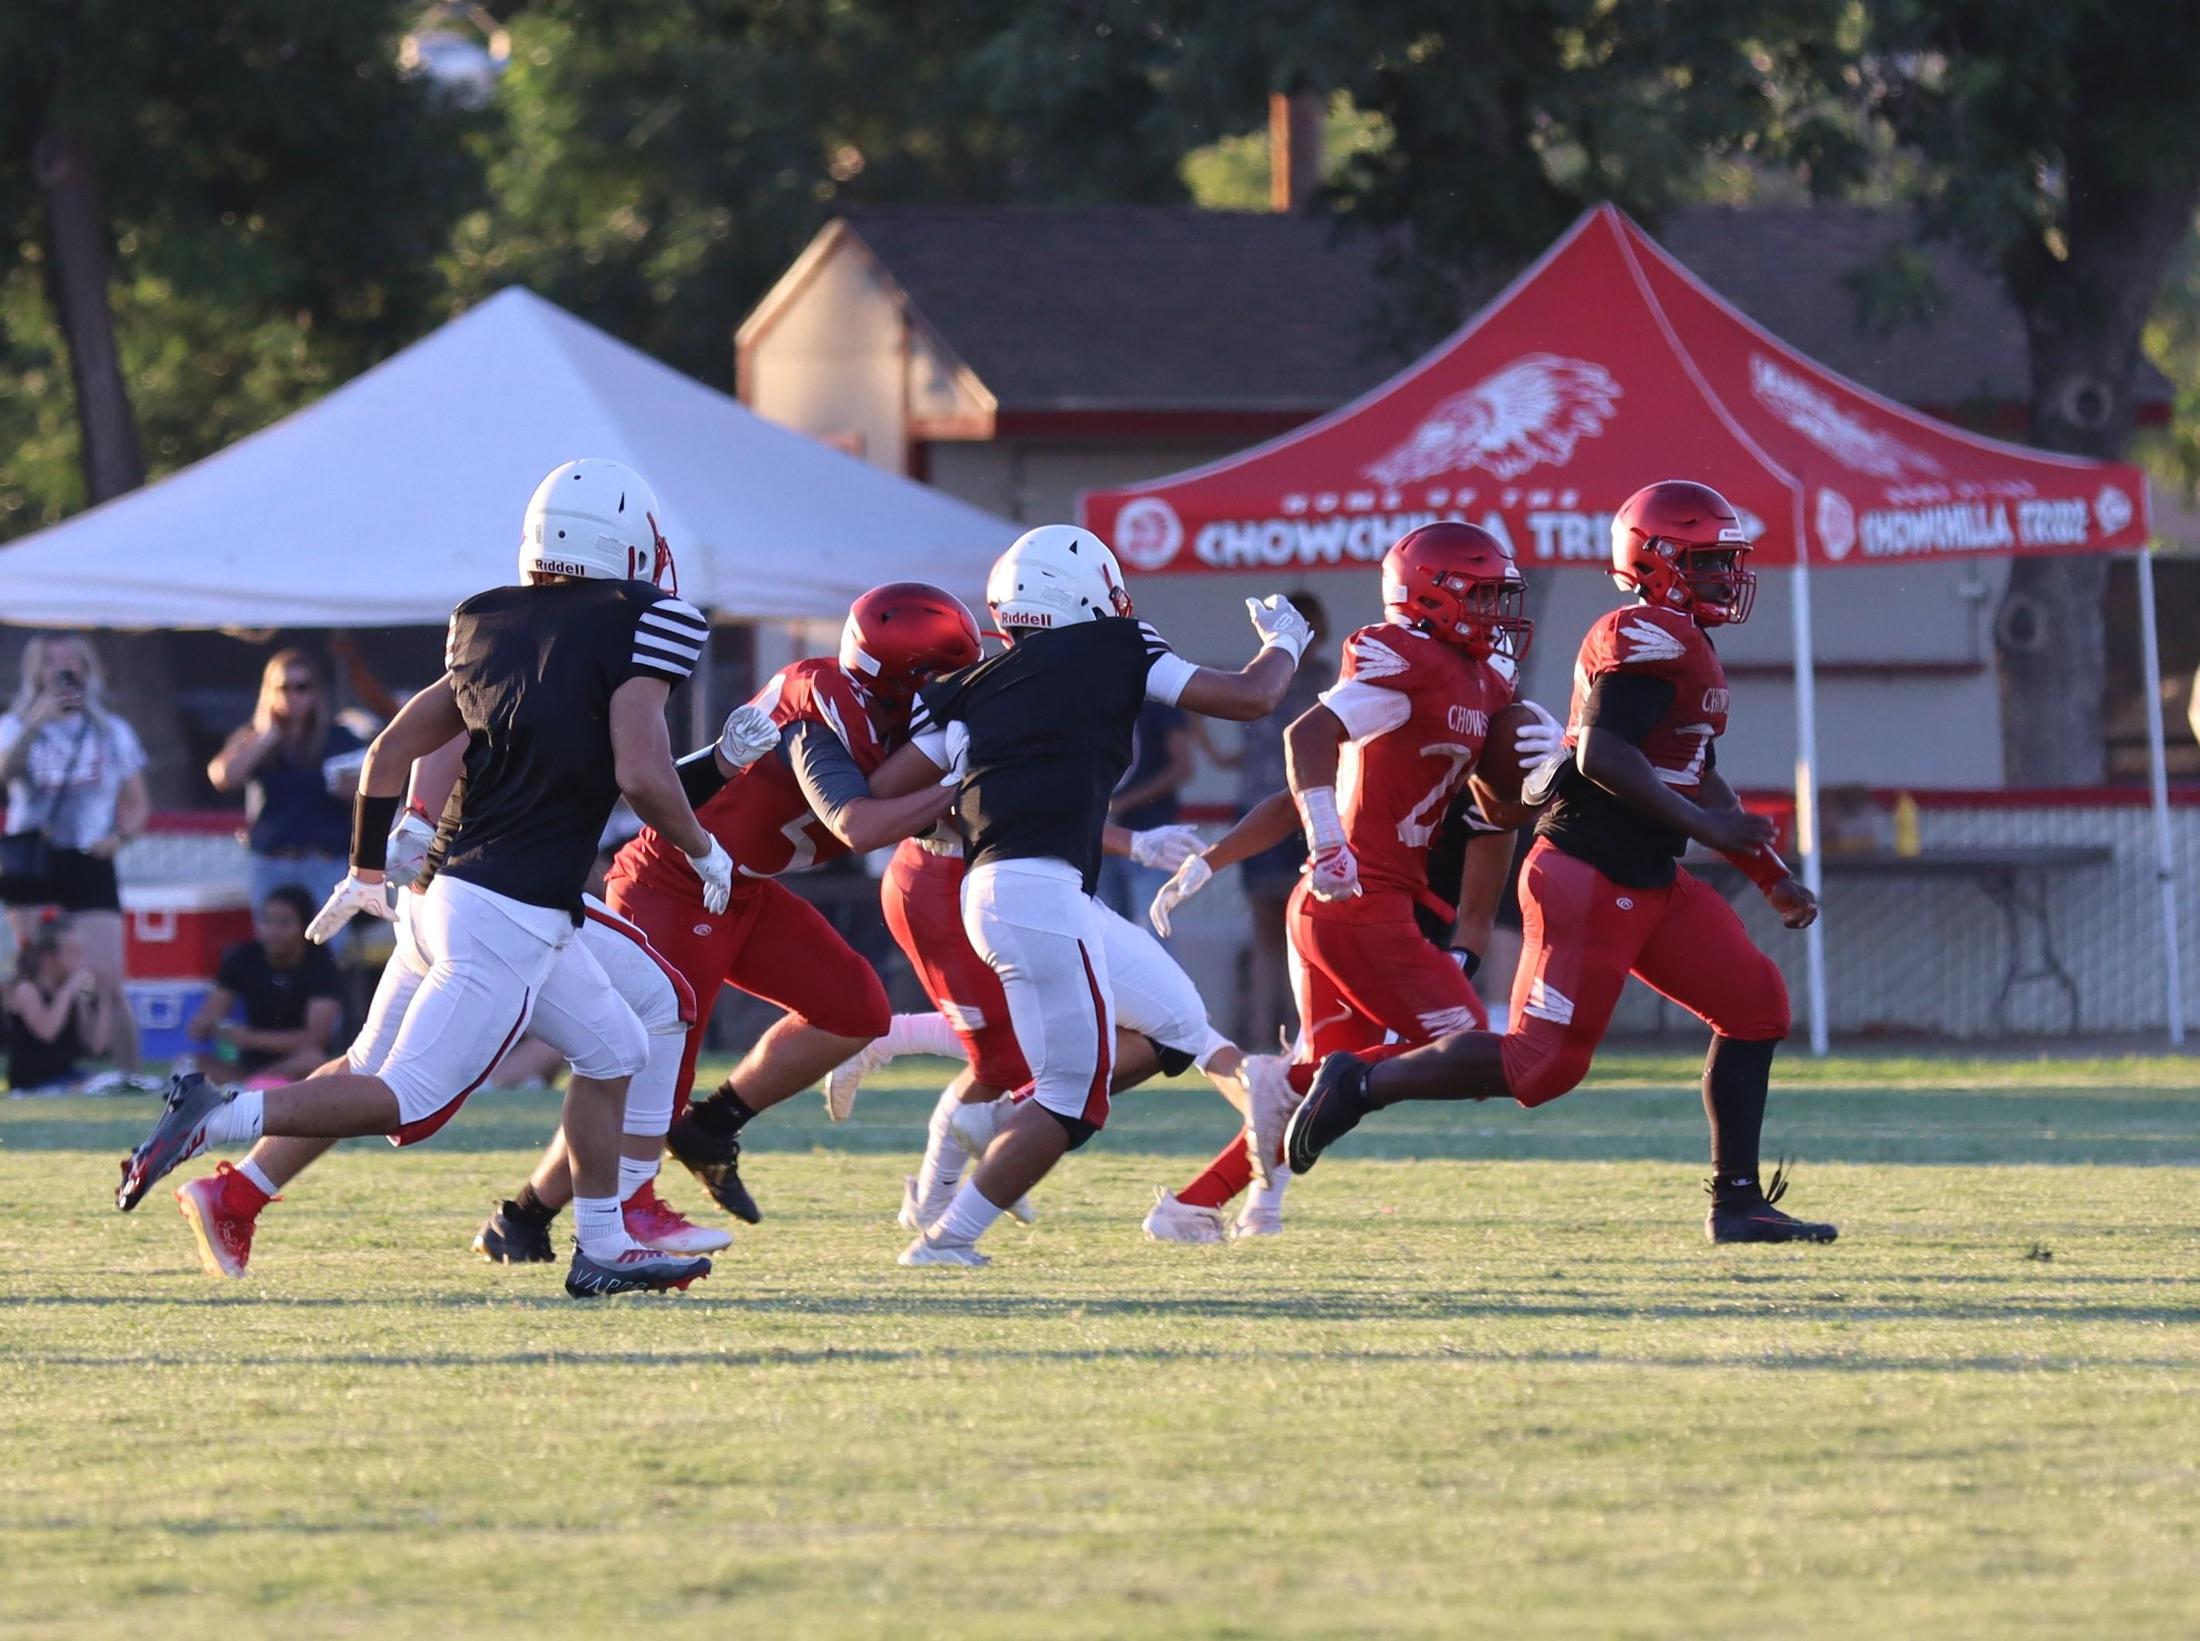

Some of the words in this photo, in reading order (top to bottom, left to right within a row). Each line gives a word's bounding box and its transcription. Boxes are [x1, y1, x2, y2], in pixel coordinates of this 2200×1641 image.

[1195, 512, 1516, 566] CHOWCHA
[1526, 511, 1614, 560] TRI
[535, 559, 585, 576] Riddell
[1001, 612, 1052, 627] Riddell
